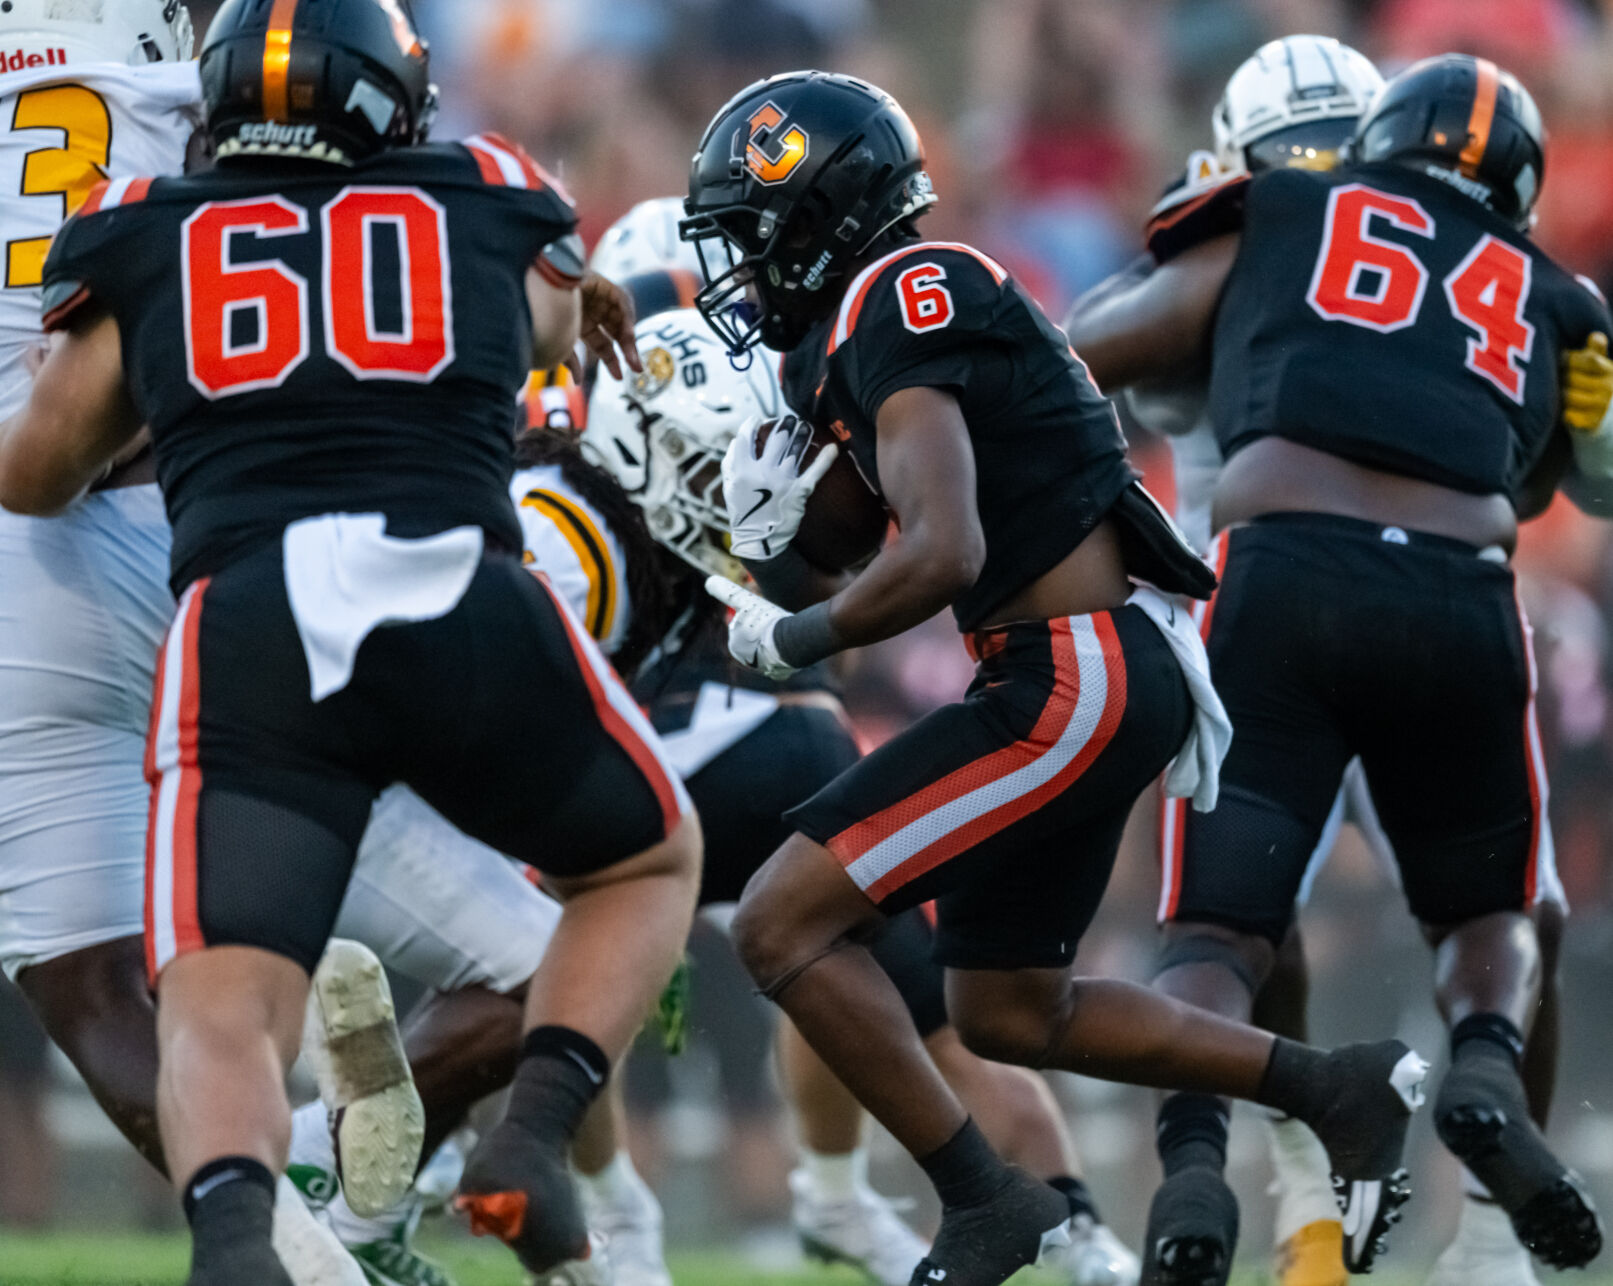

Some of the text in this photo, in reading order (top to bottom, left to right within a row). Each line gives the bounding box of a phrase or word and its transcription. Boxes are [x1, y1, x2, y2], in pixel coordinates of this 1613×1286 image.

[239, 119, 318, 146] schutt
[731, 99, 810, 187] C
[5, 83, 113, 289] 3
[181, 185, 456, 400] 60
[802, 250, 833, 288] schutt
[895, 262, 955, 334] 6
[1305, 183, 1536, 407] 64
